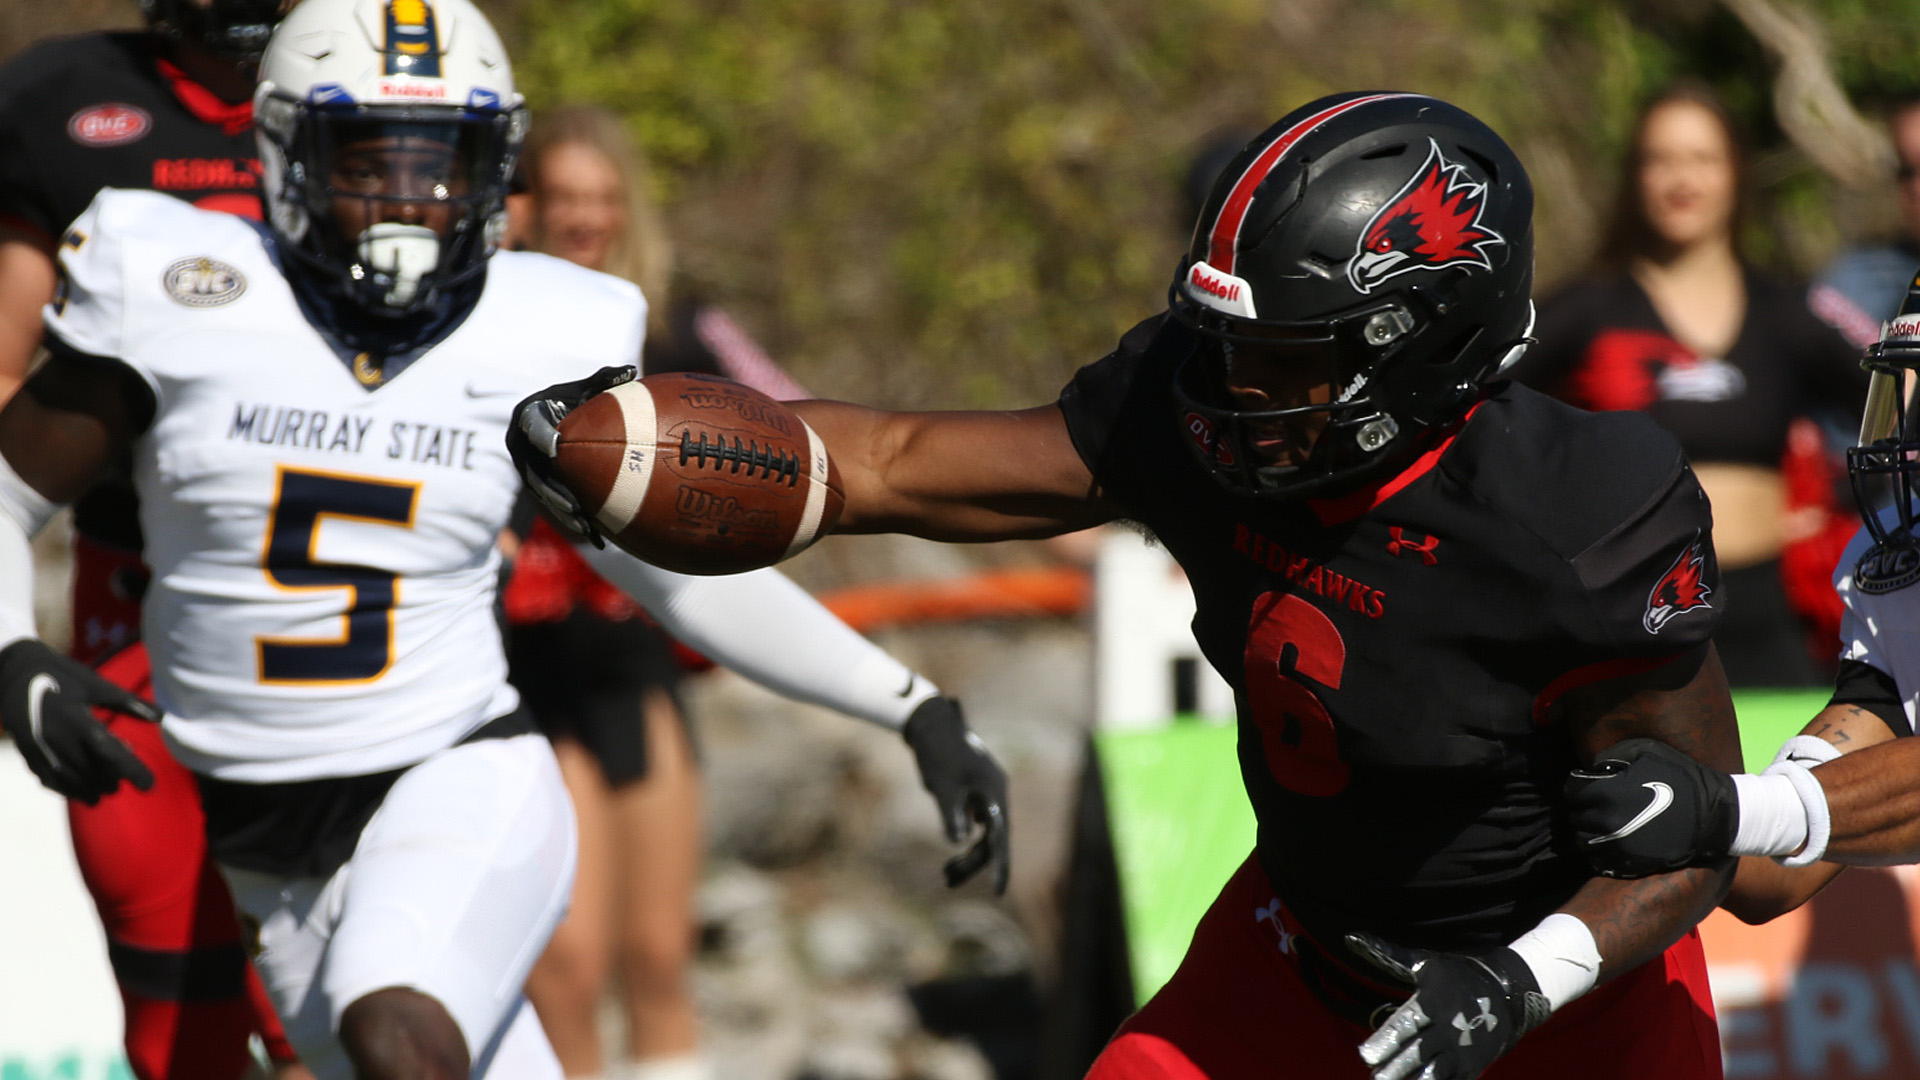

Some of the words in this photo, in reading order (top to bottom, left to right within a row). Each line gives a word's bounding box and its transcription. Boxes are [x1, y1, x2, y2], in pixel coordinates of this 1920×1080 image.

[1191, 267, 1240, 302] Riddell
[227, 400, 373, 455] MURRAY
[387, 421, 478, 471] STATE
[679, 393, 792, 437] Wilson
[675, 484, 781, 530] Wilson
[254, 461, 424, 687] 5
[1233, 522, 1386, 620] REDHAWKS
[1243, 590, 1351, 798] 6
